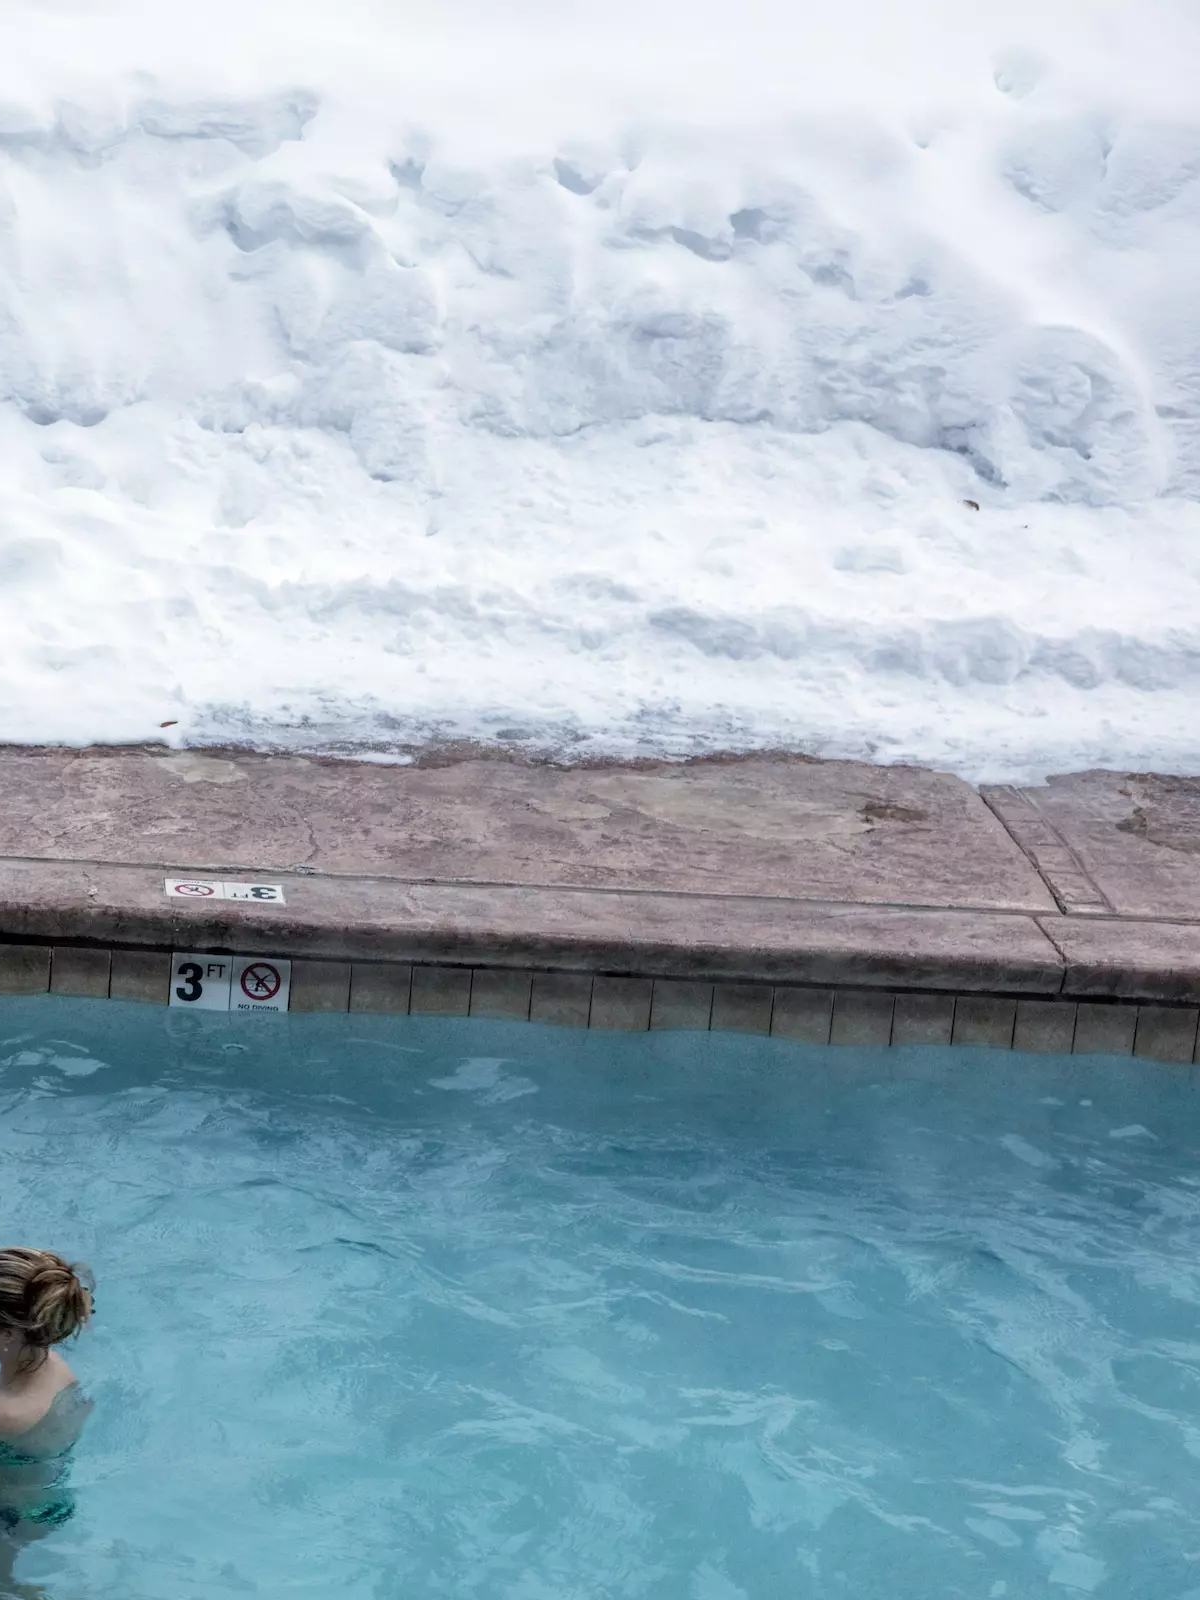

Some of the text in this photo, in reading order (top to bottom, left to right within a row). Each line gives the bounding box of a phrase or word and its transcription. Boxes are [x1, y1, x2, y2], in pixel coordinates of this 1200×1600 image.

[250, 886, 277, 899] 3
[176, 963, 226, 1001] 3 FT
